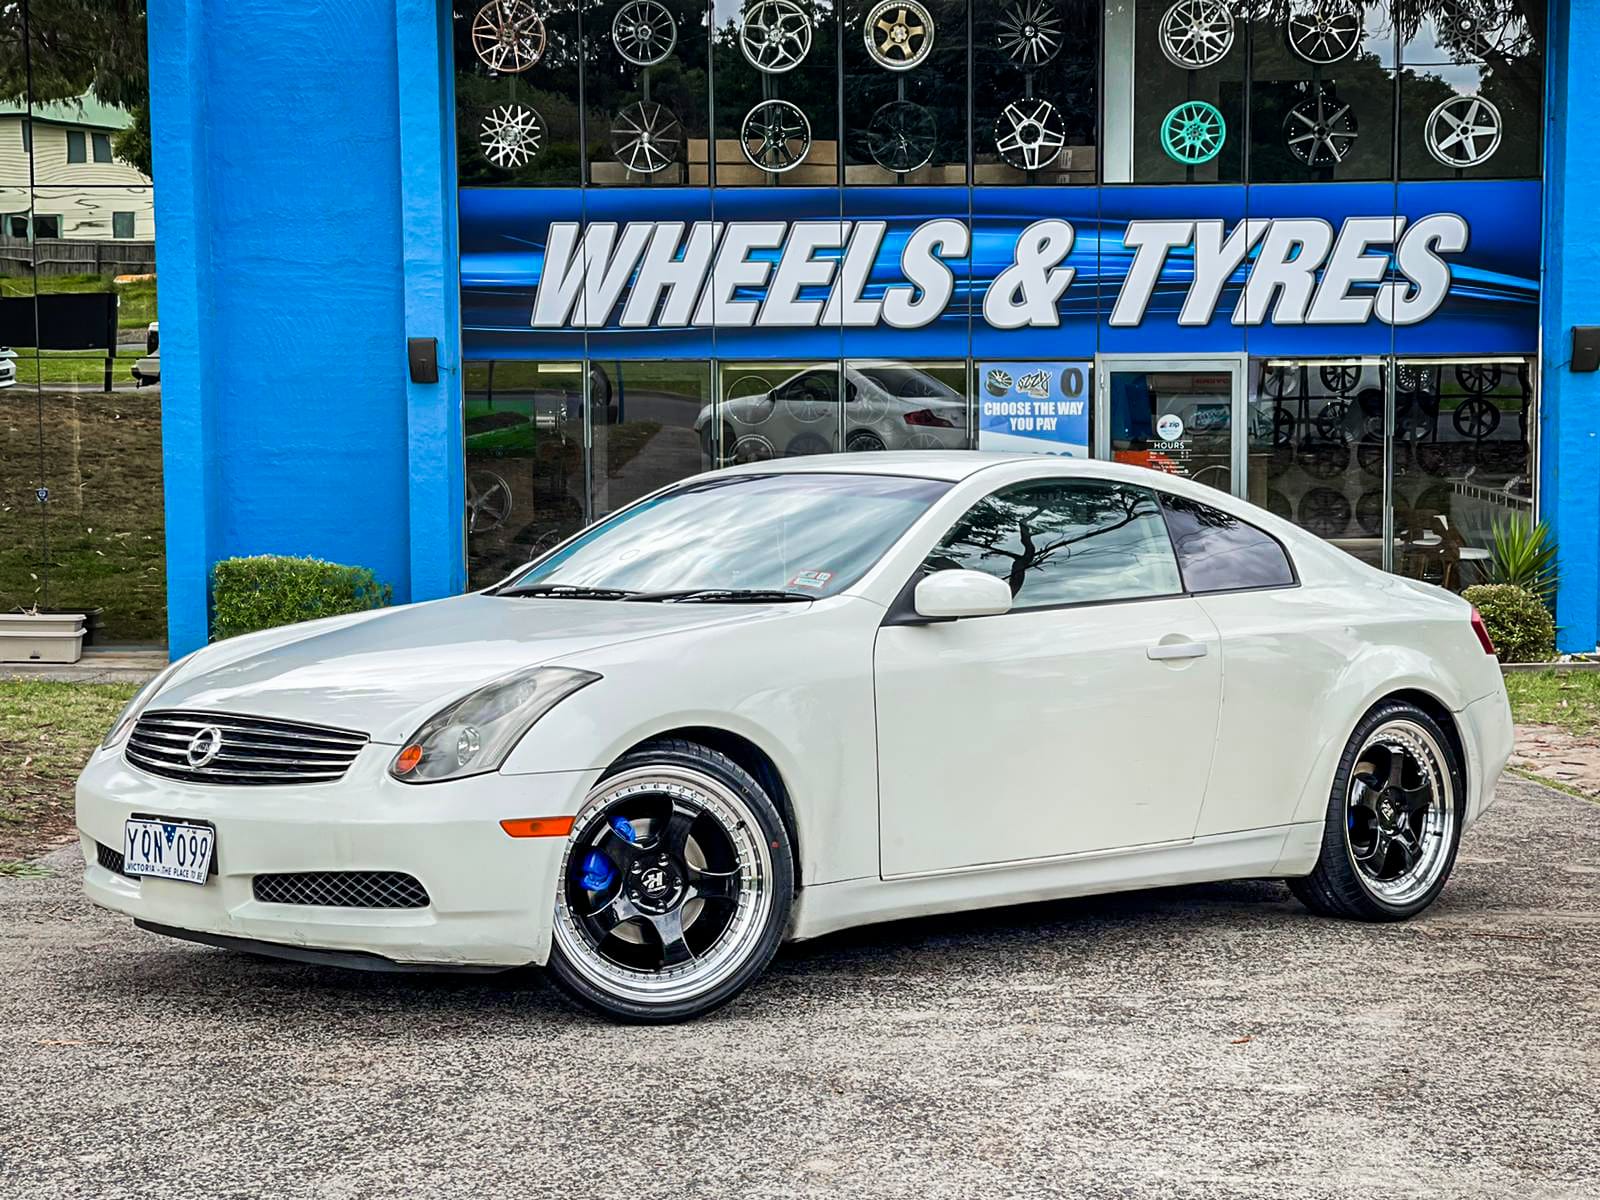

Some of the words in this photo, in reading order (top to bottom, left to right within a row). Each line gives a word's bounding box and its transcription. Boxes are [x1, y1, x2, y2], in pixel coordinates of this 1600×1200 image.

[530, 219, 971, 329] WHEELS
[984, 218, 1076, 329] &
[1108, 213, 1469, 326] TYRES
[983, 401, 1032, 416] CHOOSE
[1033, 401, 1056, 416] THE
[1057, 401, 1084, 416] WAY
[1009, 417, 1034, 431] YOU
[1036, 417, 1058, 431] PAY
[1168, 421, 1180, 429] zip
[1153, 441, 1185, 450] HOURS
[127, 828, 163, 864] YQN
[176, 833, 208, 869] 099
[126, 863, 155, 873] VICTORIA
[161, 866, 172, 875] THE
[173, 867, 189, 879] PLACE
[190, 870, 196, 879] TO
[197, 871, 204, 881] BE
